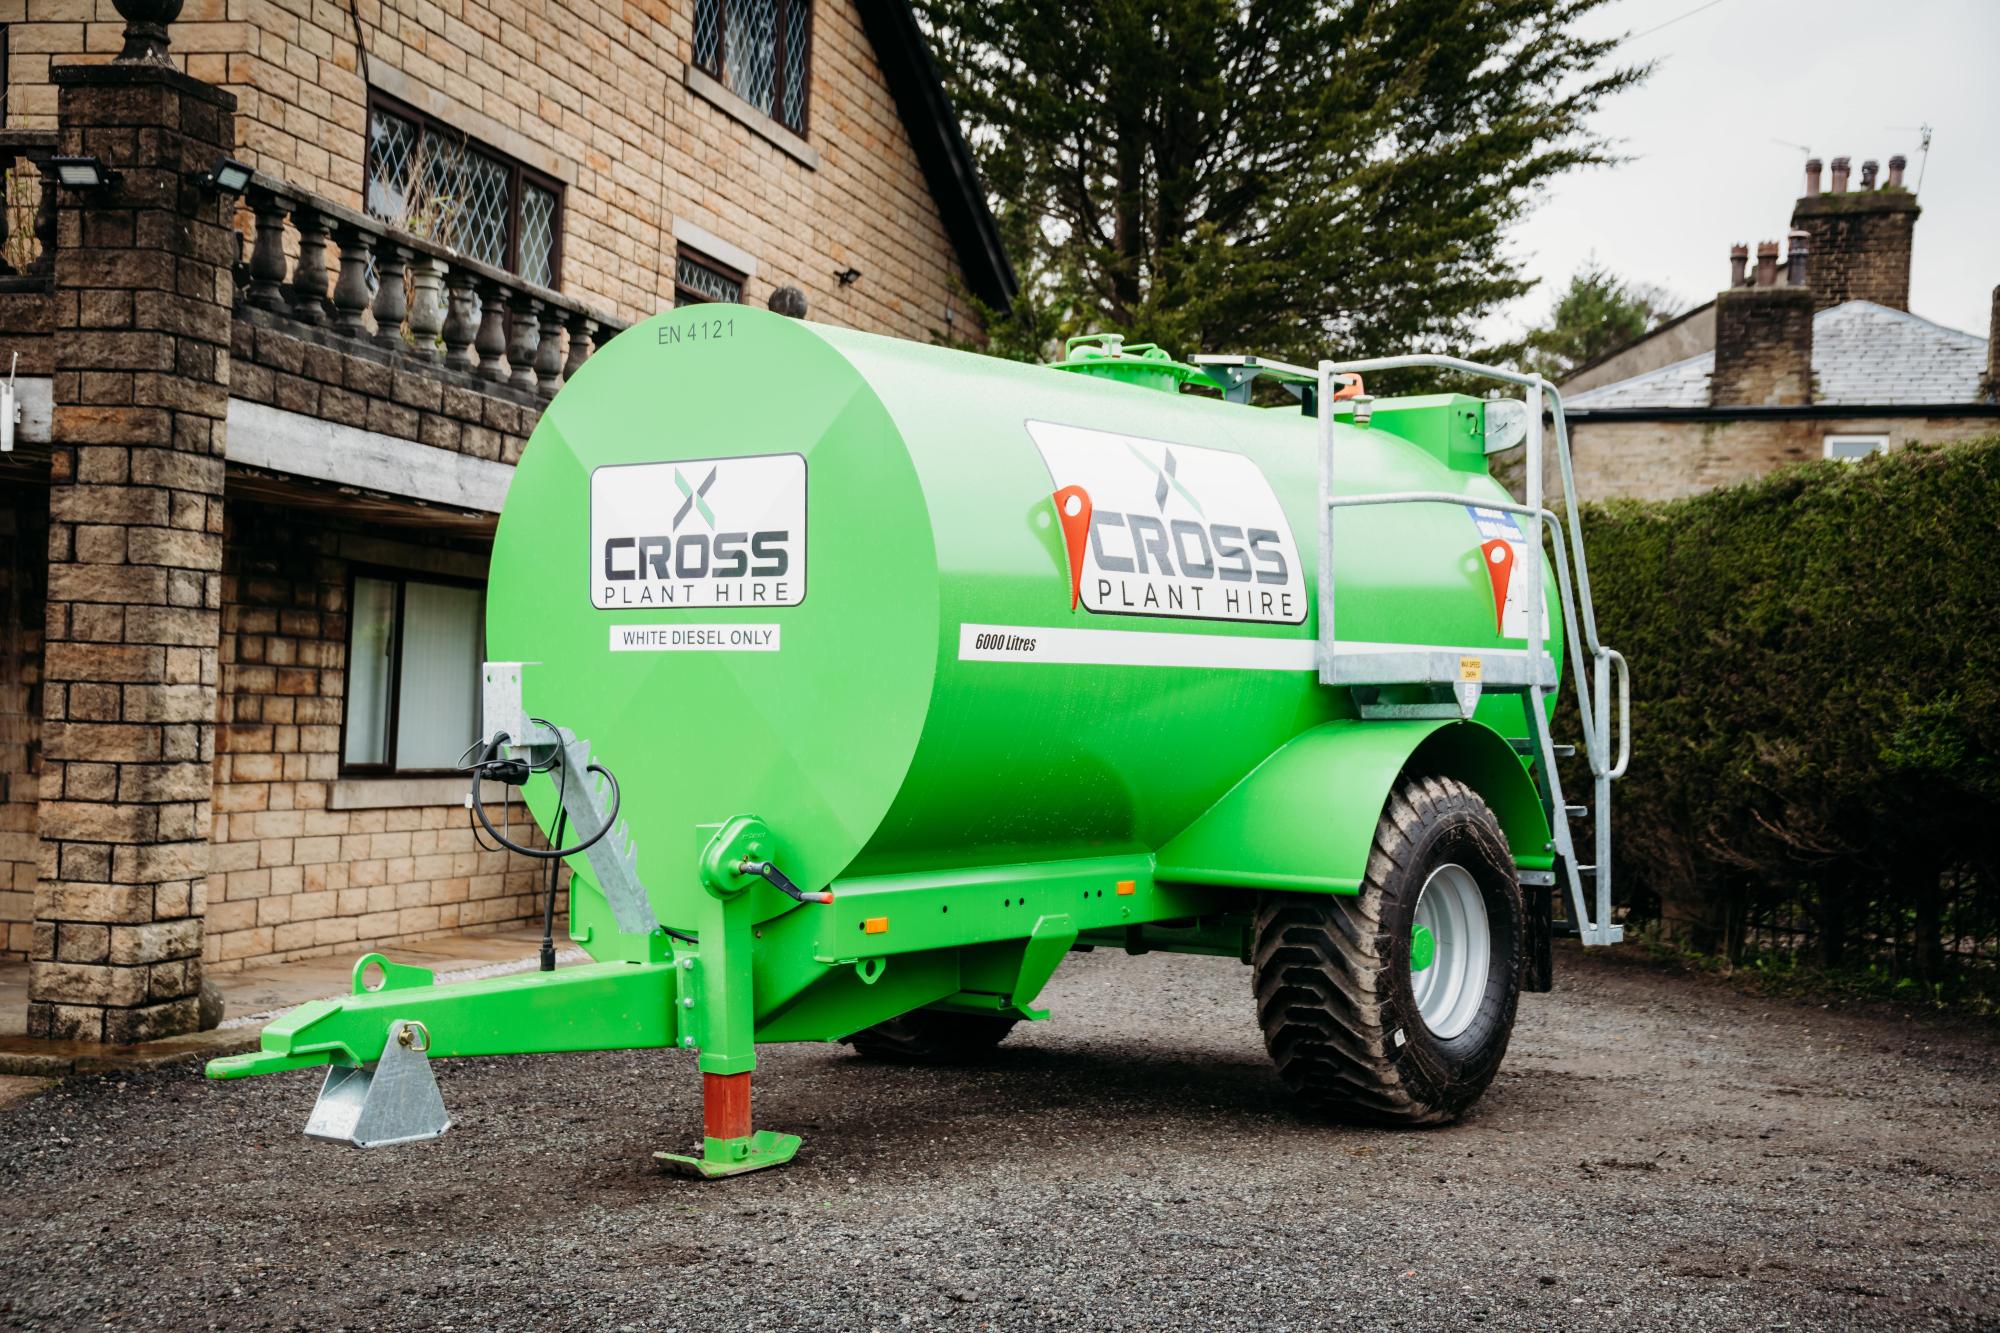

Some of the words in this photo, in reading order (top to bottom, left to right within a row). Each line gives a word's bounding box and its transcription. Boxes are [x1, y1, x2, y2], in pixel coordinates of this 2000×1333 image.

[658, 325, 681, 345] EN
[687, 318, 735, 342] 4121
[604, 530, 789, 581] CROSS
[1089, 509, 1289, 586] CROSS
[604, 584, 695, 605] PLANT
[715, 582, 789, 603] HIRE
[1097, 578, 1204, 611] PLANT
[1225, 588, 1293, 617] HIRE
[622, 630, 667, 646] WHITE
[672, 629, 726, 646] DIESEL
[730, 629, 772, 645] ONLY
[975, 633, 1005, 651] 6000
[1006, 634, 1037, 652] Litres
